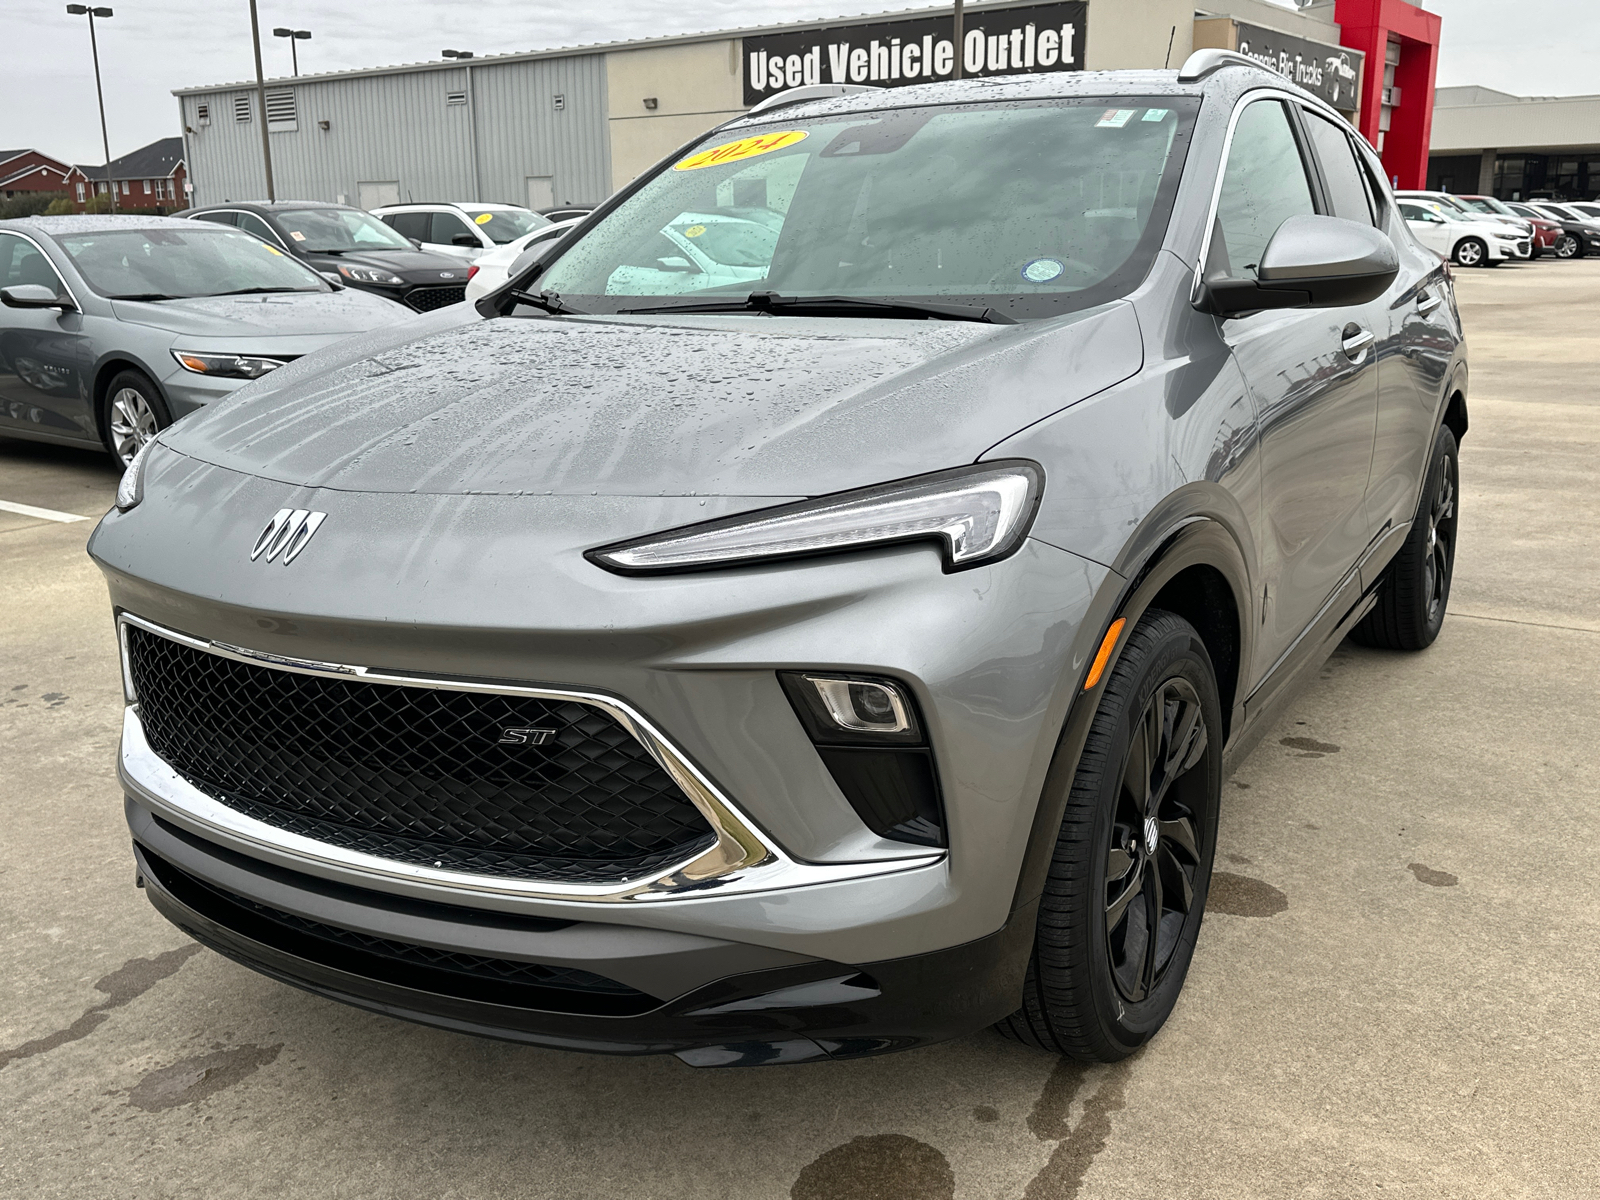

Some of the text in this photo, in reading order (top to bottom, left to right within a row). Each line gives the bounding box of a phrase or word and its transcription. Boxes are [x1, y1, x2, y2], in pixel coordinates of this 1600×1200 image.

[750, 23, 1075, 91] Used Vehicle Outlet
[1295, 55, 1323, 86] Trucks
[687, 133, 793, 168] 2024
[498, 728, 556, 745] ST
